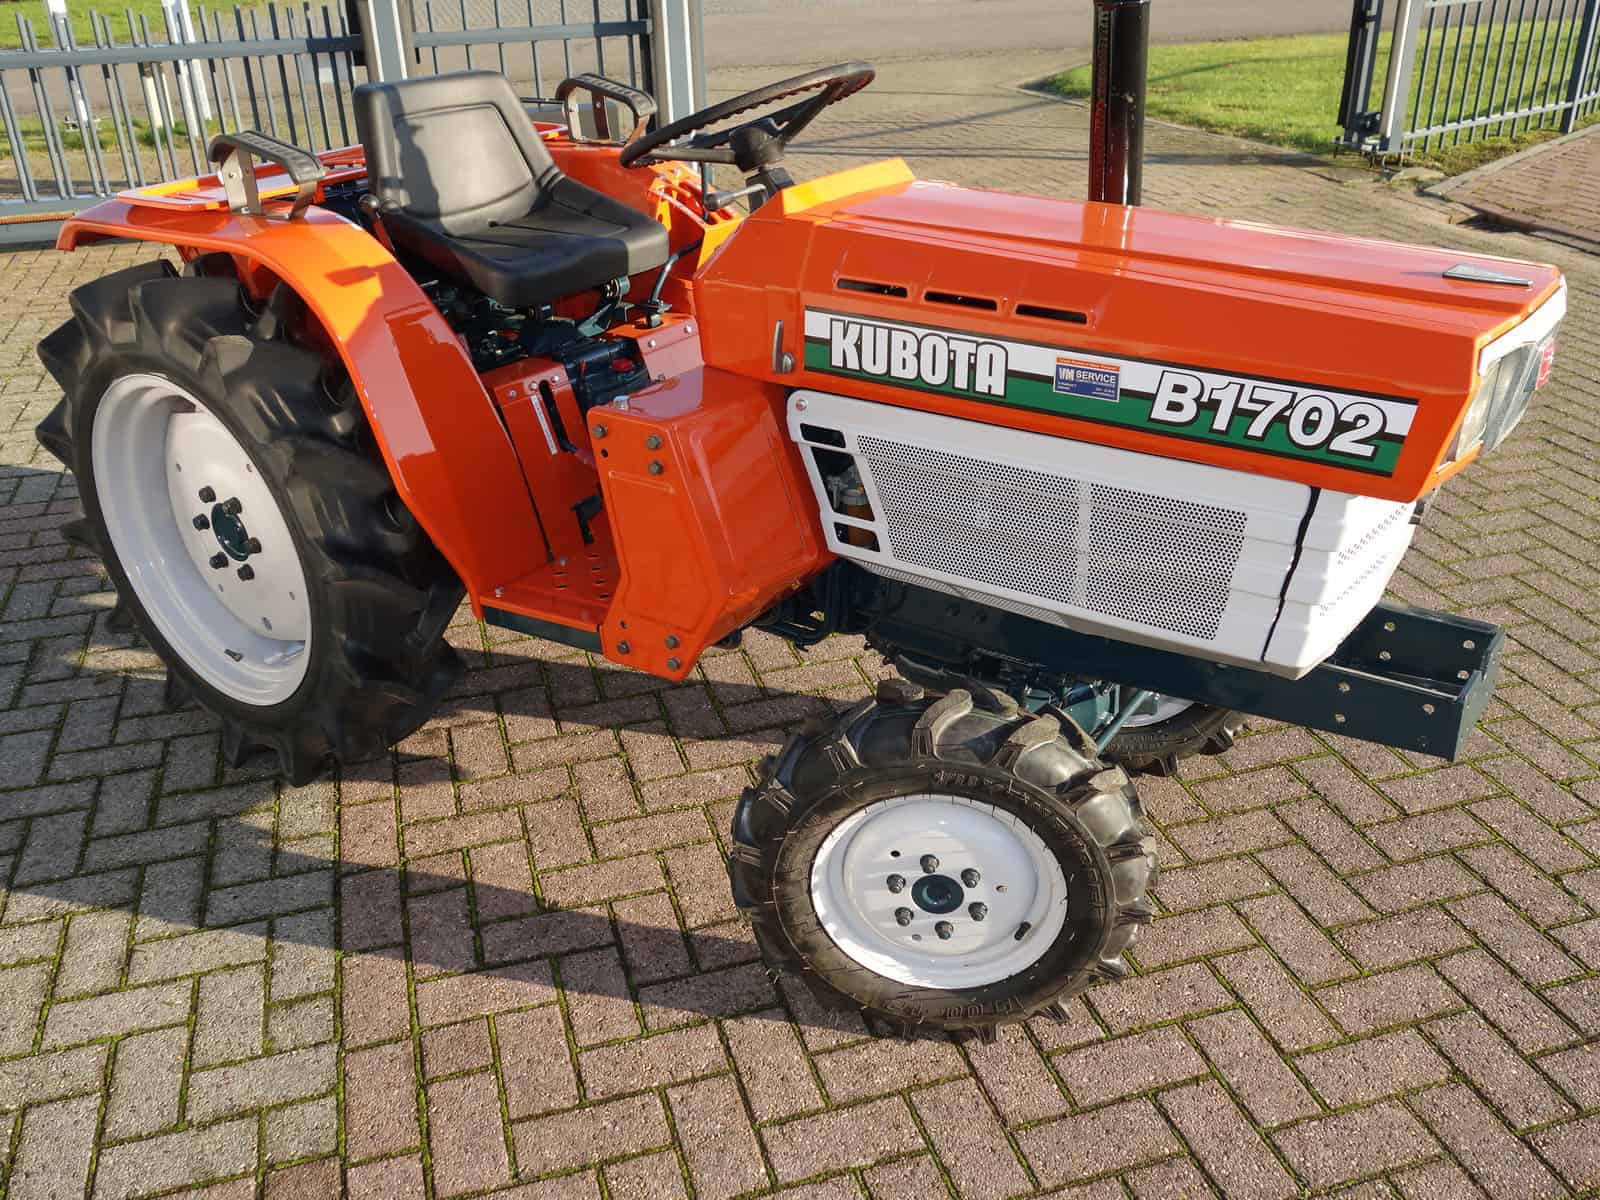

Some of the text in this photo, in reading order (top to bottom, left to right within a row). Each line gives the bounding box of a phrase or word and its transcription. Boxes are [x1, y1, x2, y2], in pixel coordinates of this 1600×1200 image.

[831, 319, 1007, 397] KUBOTA
[1075, 369, 1117, 384] SERVICE
[1150, 370, 1387, 458] B1702
